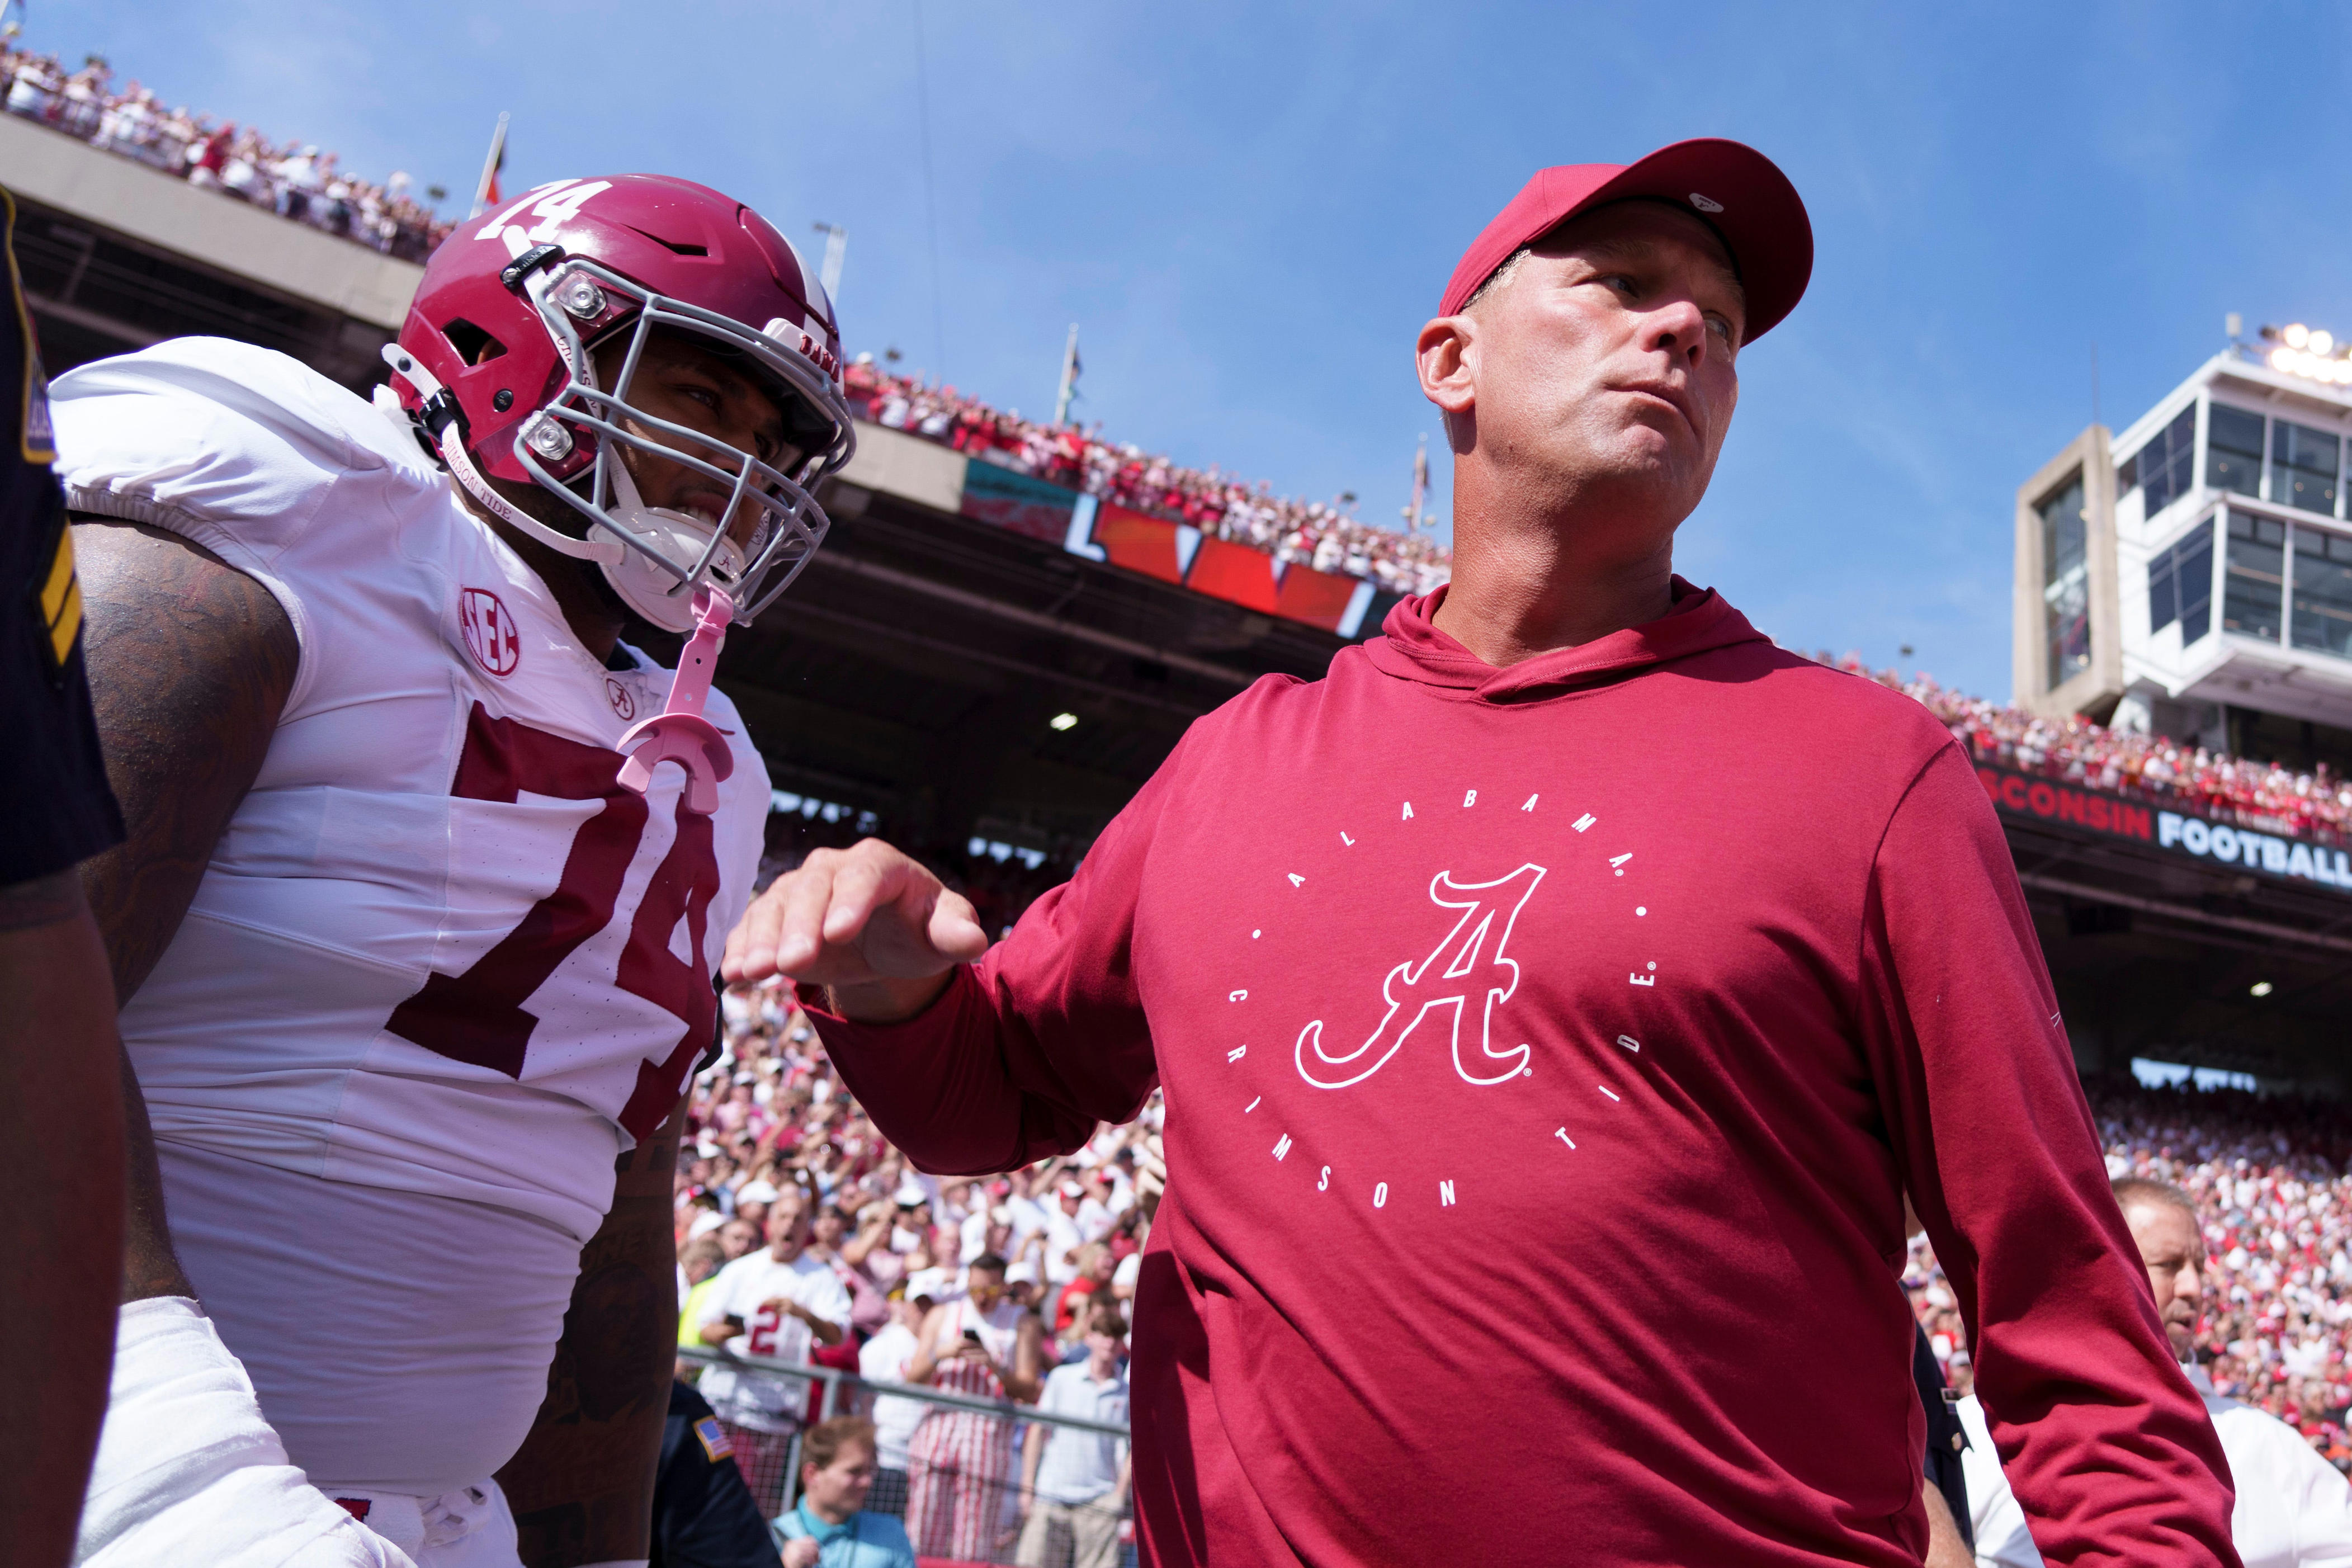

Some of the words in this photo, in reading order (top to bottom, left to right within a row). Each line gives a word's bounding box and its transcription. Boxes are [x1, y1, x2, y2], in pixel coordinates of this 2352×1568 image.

[474, 178, 613, 243] 74
[799, 334, 840, 384] BAMA
[480, 487, 512, 520] TIDE
[462, 591, 517, 672] SEC
[1288, 790, 1633, 887] ALABAMA
[1977, 767, 2152, 841] SCONSIN
[2157, 811, 2351, 888] FOOTBALL
[384, 700, 720, 1146] 74
[1227, 989, 1456, 1208] CRIMSON
[1555, 972, 1655, 1149] TIDE
